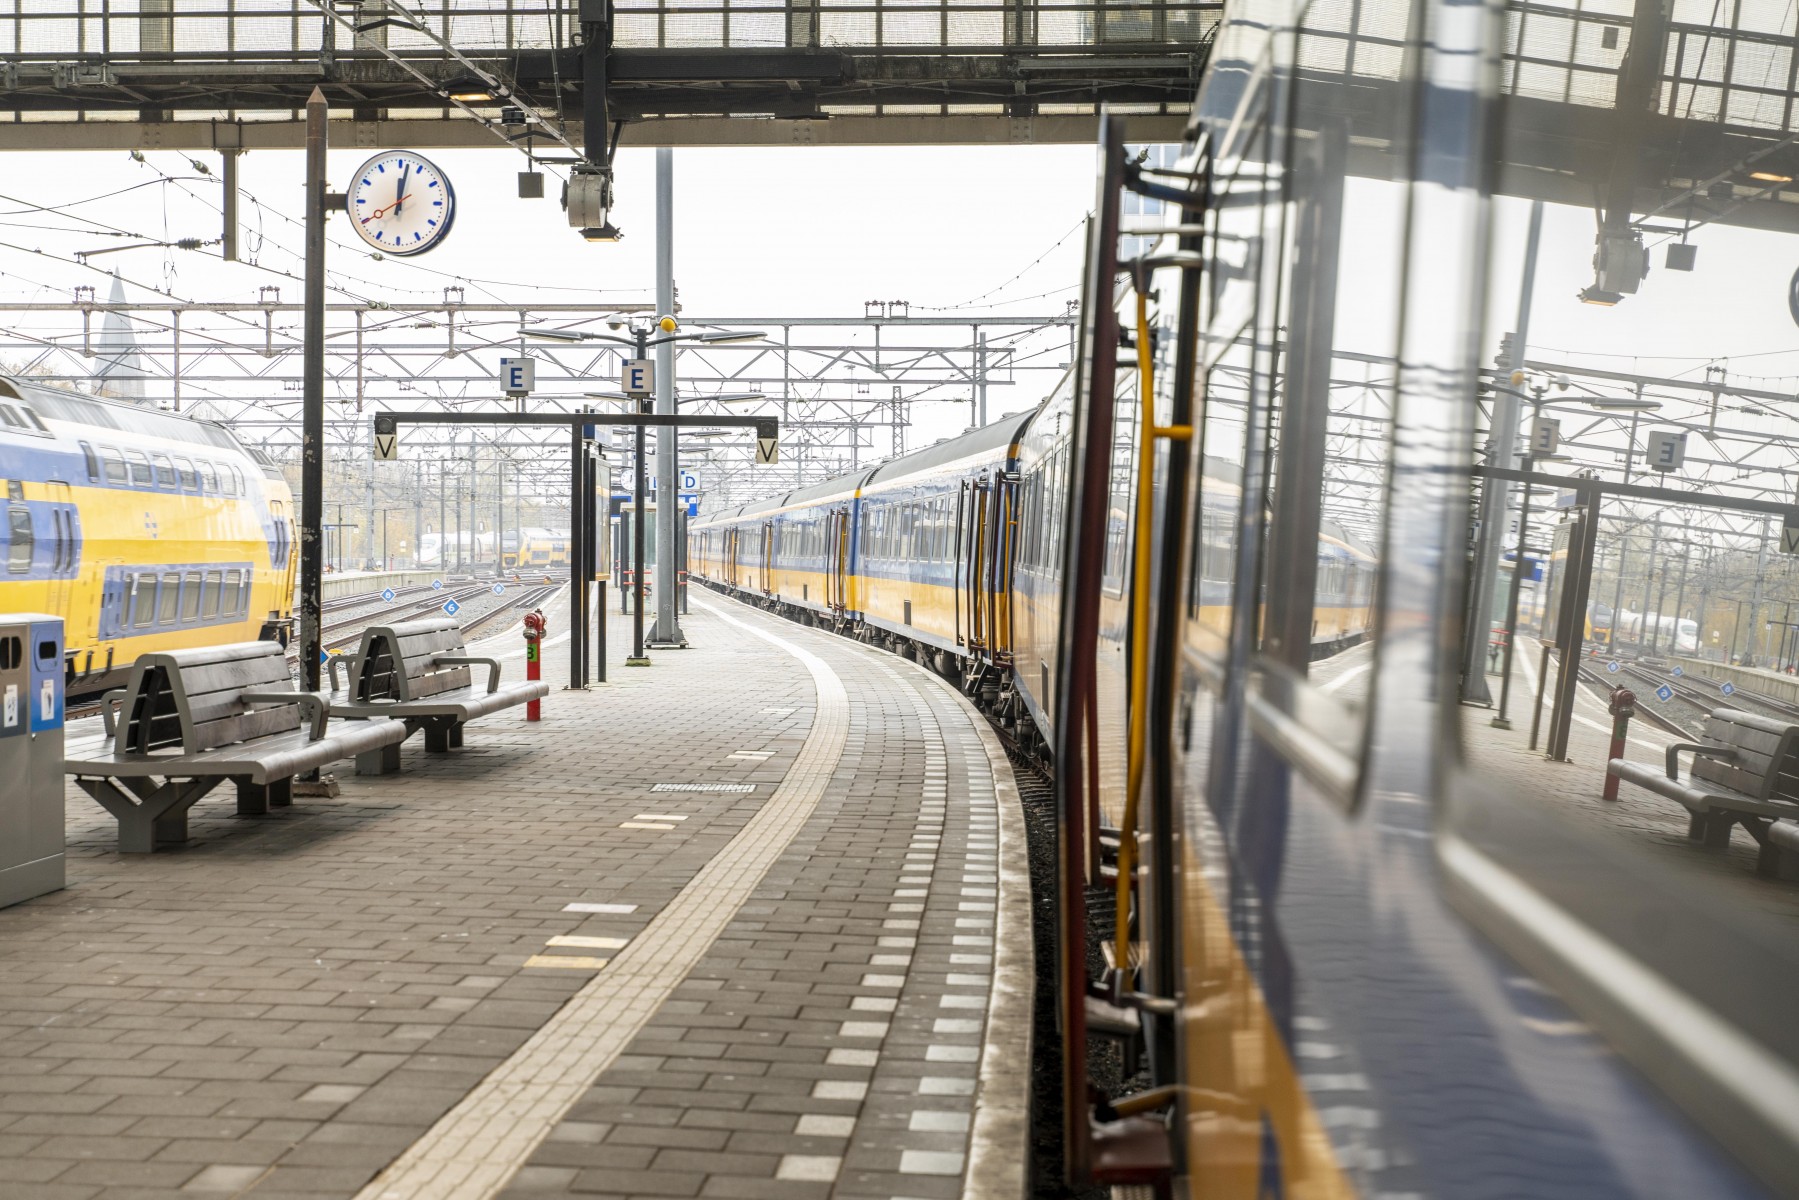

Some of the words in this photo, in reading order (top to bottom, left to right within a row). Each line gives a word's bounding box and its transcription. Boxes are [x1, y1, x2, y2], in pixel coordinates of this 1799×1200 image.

[510, 367, 523, 388] E
[631, 368, 644, 389] E
[376, 436, 395, 459] V
[758, 440, 777, 463] V
[685, 476, 696, 489] D
[448, 603, 455, 612] 6
